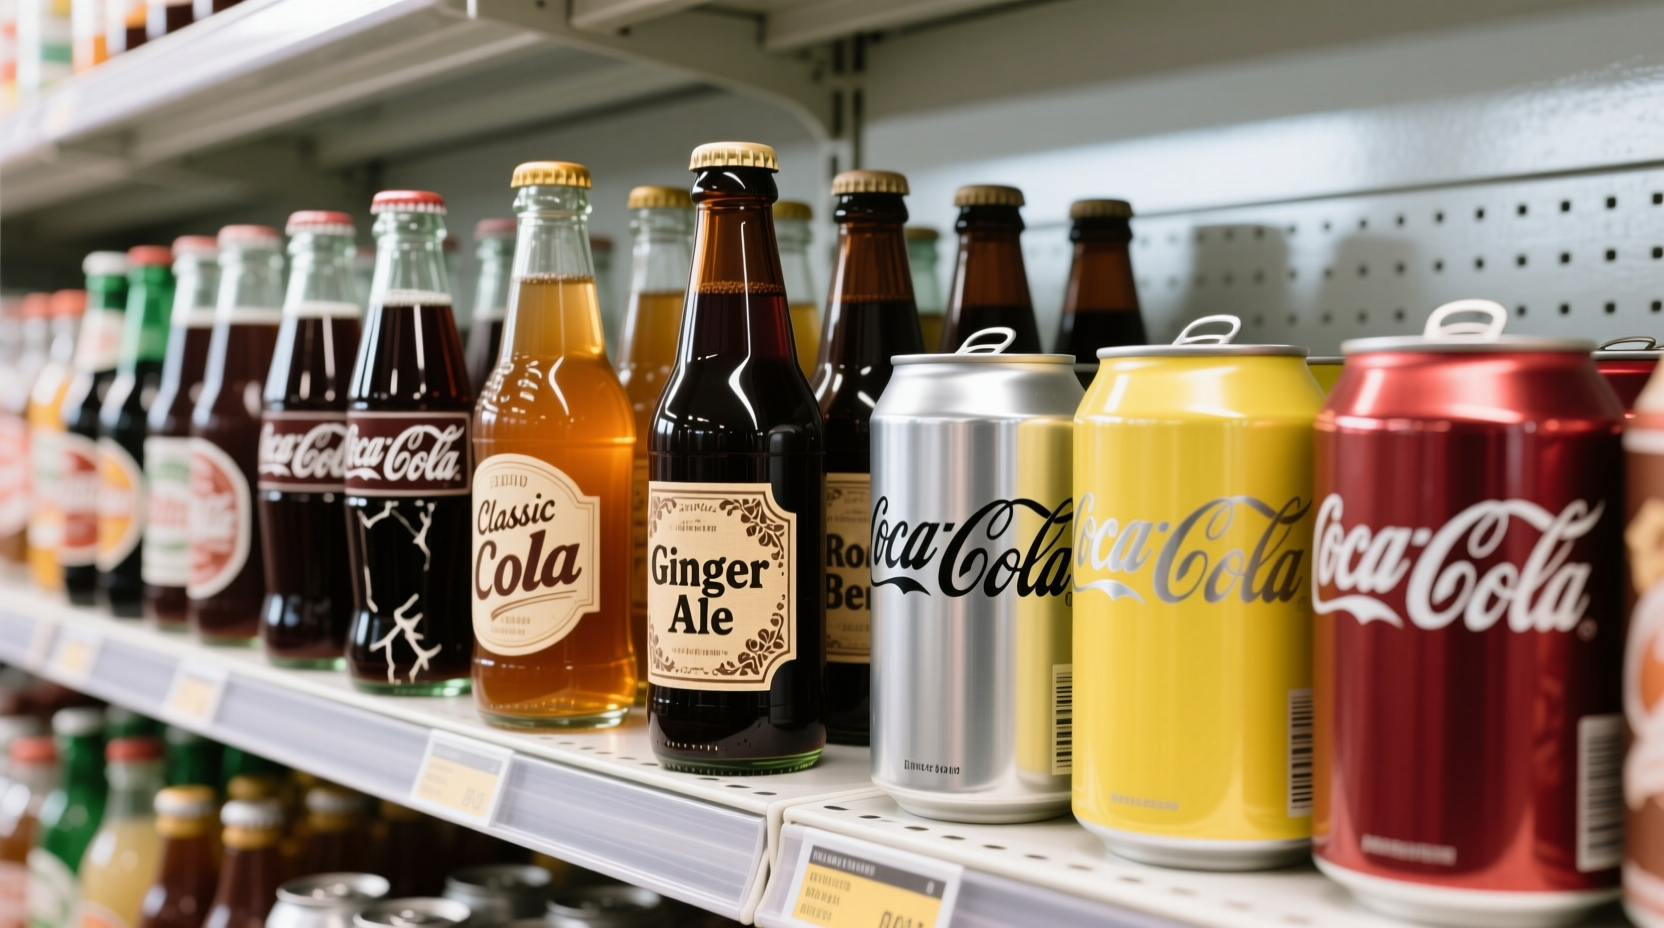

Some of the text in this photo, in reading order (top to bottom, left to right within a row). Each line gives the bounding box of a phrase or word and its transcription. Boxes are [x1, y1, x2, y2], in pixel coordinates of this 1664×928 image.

[477, 493, 555, 535] Classic
[870, 496, 1073, 598] Coca-Cola
[1073, 492, 1313, 606] Coca-Cola
[475, 529, 582, 600] Cola
[651, 544, 770, 598] Ginger
[1311, 493, 1605, 633] Coca-Cola
[667, 594, 734, 636] Ale
